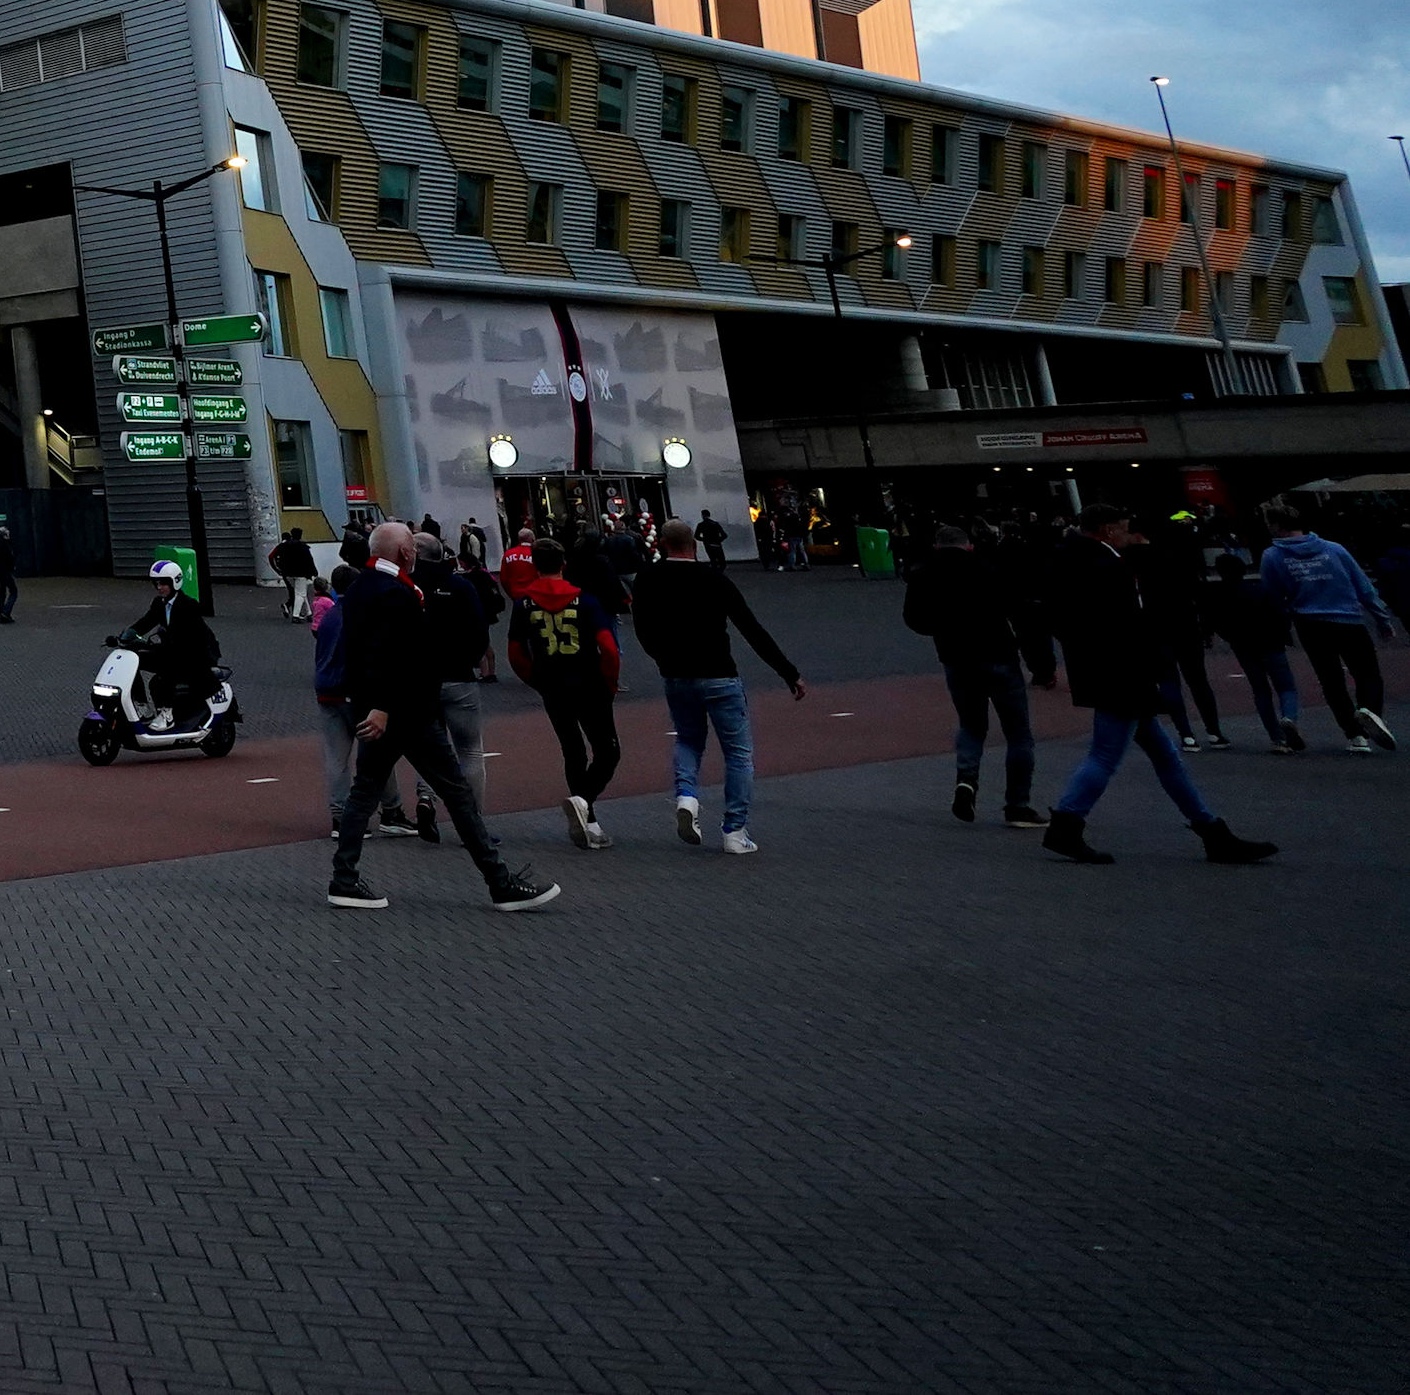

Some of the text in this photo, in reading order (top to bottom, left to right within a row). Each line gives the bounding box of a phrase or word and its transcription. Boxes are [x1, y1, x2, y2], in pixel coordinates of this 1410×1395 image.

[184, 323, 207, 331] Dome
[103, 329, 135, 341] Ingang D
[104, 339, 152, 351] Stadionkassa
[137, 360, 169, 369] Strandvliet
[135, 371, 174, 380] Duivendrecht
[193, 399, 229, 409] Hoofdingang
[134, 436, 155, 446] Ingang
[530, 608, 580, 656] 35
